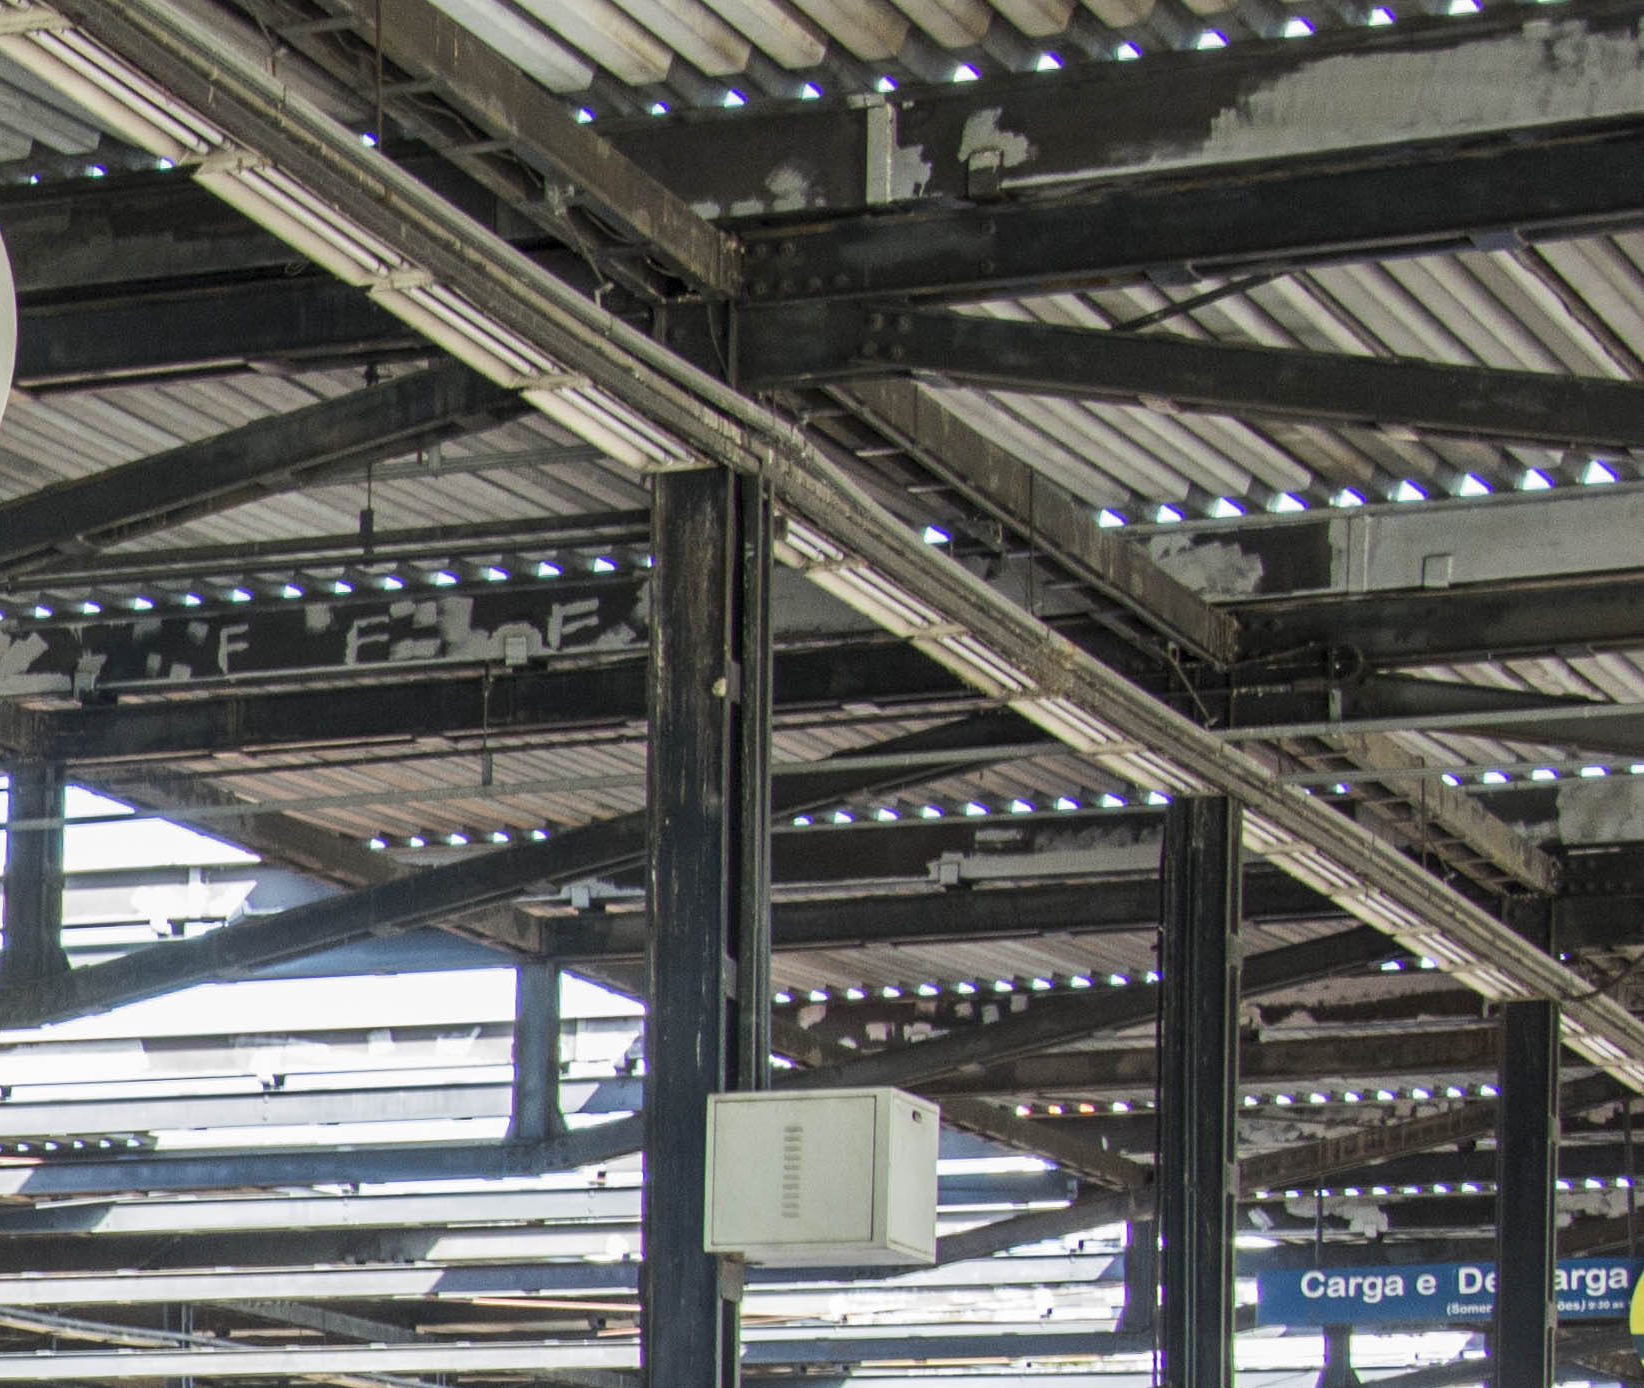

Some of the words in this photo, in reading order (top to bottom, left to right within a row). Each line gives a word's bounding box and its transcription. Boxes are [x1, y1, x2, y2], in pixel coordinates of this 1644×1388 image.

[1300, 1270, 1404, 1303] Carga
[1416, 1274, 1437, 1296] e
[1458, 1265, 1629, 1298] Dearga
